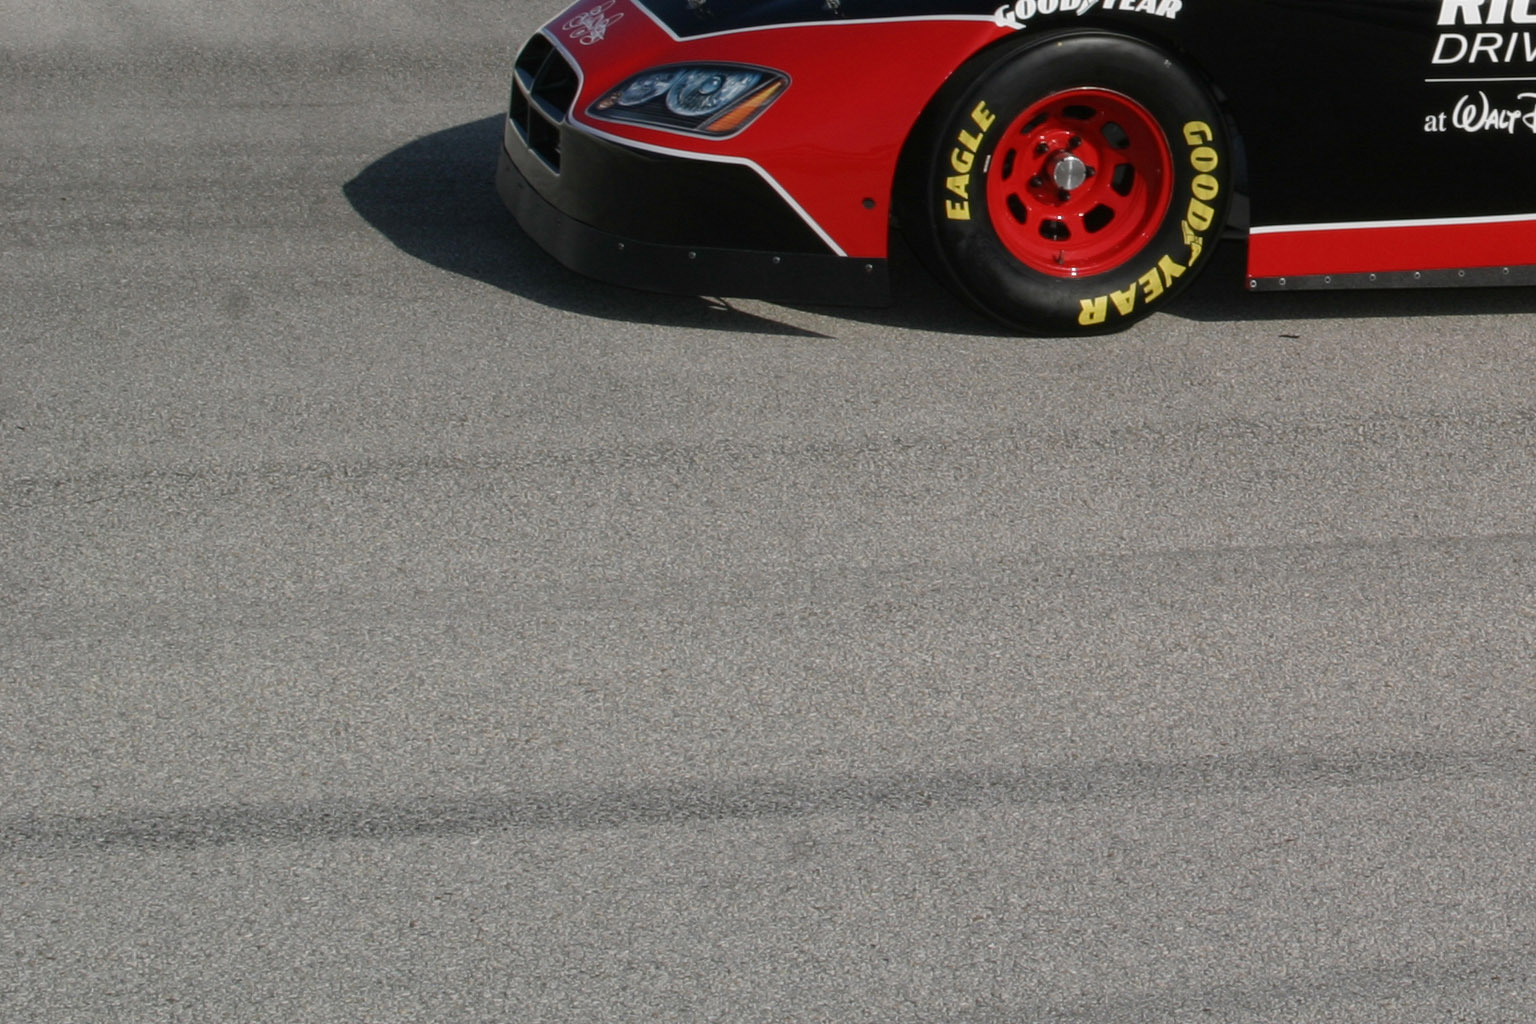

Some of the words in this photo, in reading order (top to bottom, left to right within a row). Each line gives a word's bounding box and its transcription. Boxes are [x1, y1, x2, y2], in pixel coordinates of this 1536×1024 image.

[945, 100, 996, 221] EAGLE
[1424, 112, 1446, 133] at
[1077, 120, 1219, 326] GOODYEAR
